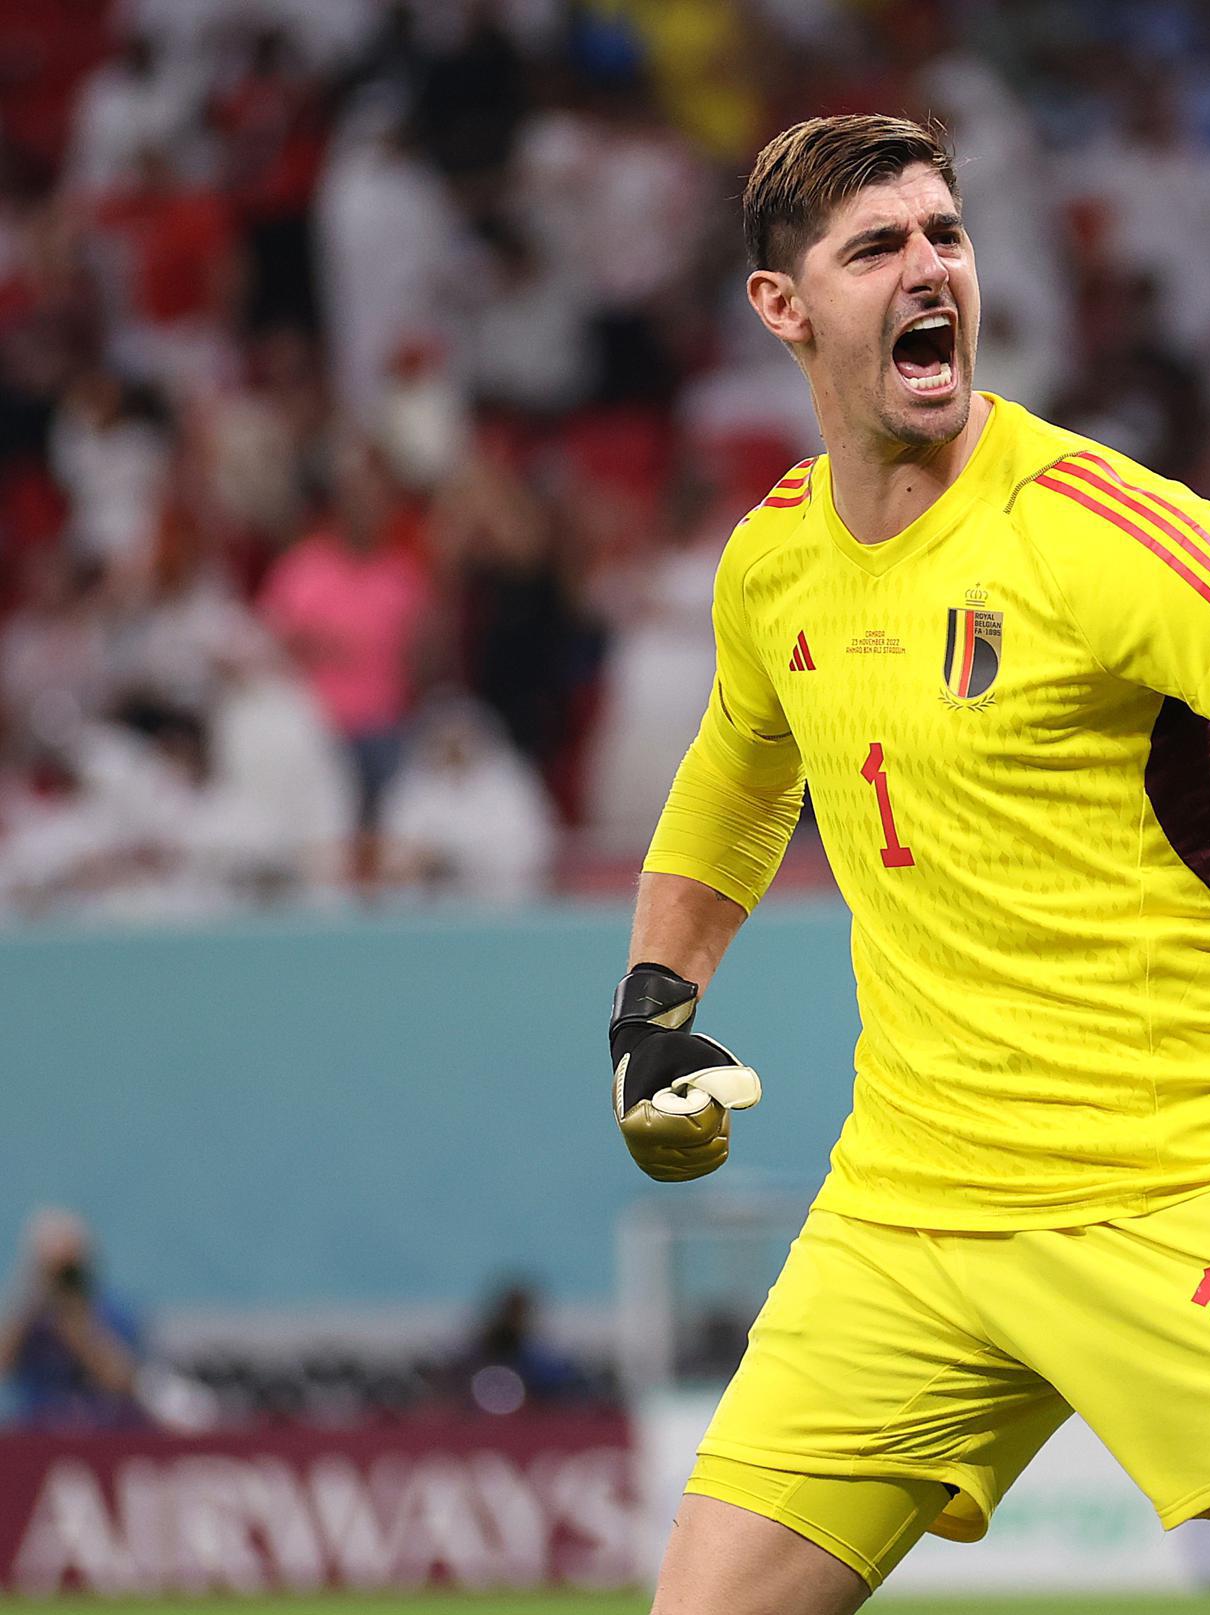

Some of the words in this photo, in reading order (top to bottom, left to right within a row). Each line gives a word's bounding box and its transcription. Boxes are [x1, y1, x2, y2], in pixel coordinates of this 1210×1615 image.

[975, 613, 995, 621] ROYAL
[975, 620, 1002, 629] BELGIAN
[865, 630, 886, 638] CANADA
[851, 638, 858, 646] 23
[859, 638, 885, 646] NOVEMBER
[886, 638, 900, 646] 2022
[883, 646, 906, 654] STADIUM
[861, 742, 915, 868] 1
[10, 1450, 642, 1592] AIRWAYS
